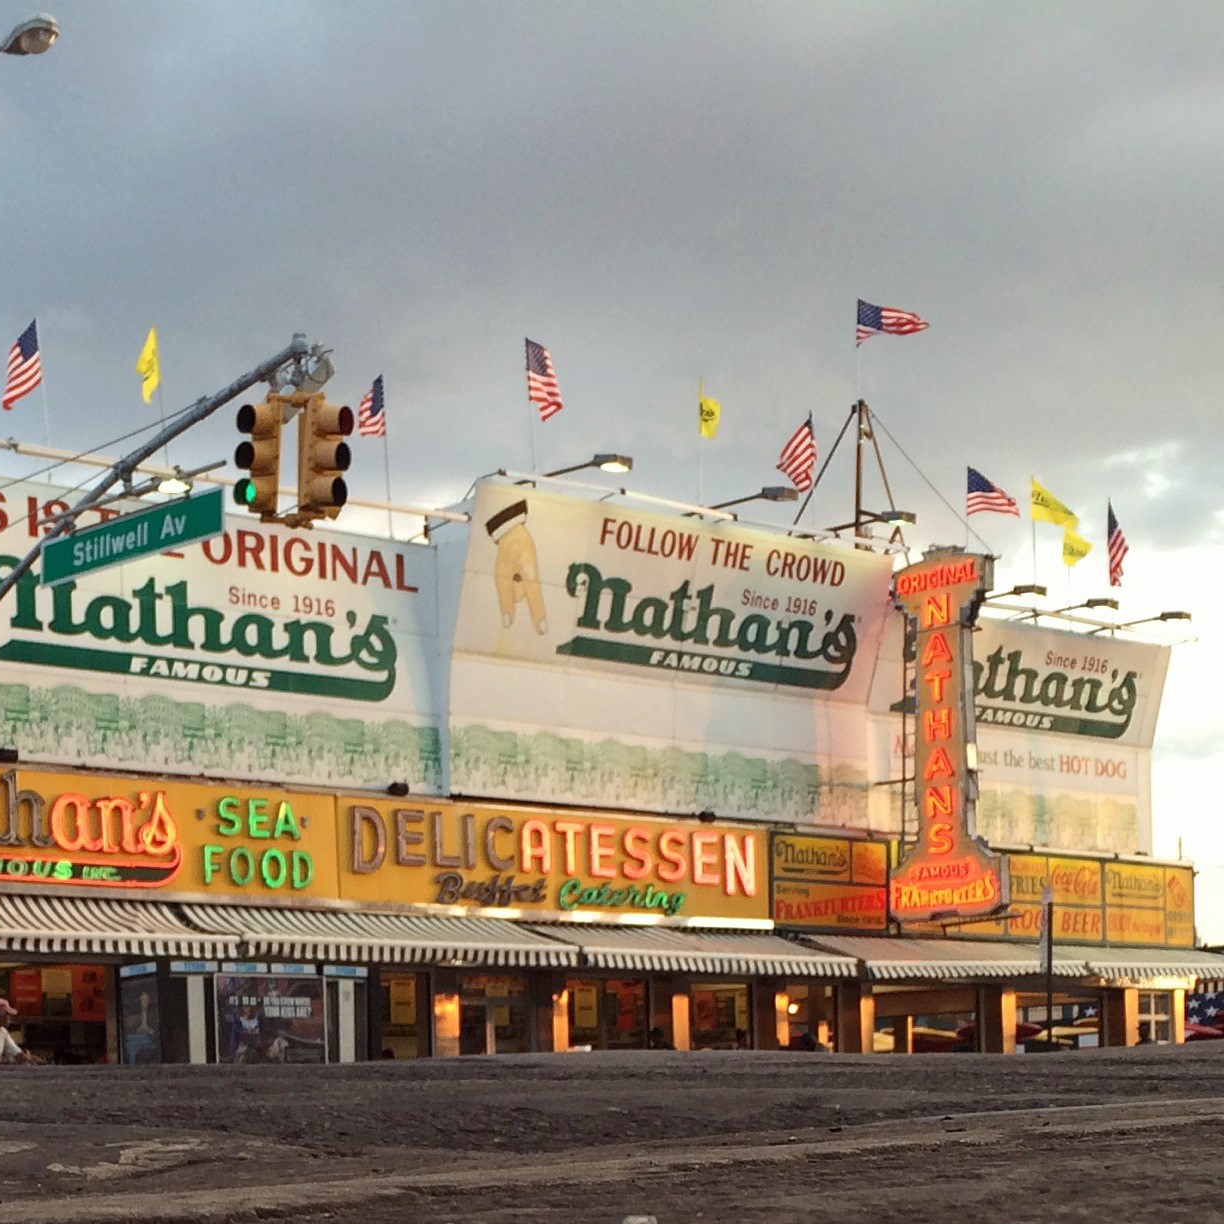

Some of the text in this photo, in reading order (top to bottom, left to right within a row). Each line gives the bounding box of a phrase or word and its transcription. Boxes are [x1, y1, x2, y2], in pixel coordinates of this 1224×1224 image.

[72, 521, 149, 567] Stillwell
[160, 513, 188, 541] Av
[599, 518, 847, 588] FOLLOW THE CROWD
[201, 529, 419, 594] ORIGINAL
[897, 558, 978, 595] ORIGINAL
[228, 586, 336, 618] Since 1916
[565, 562, 858, 665] Nathan's
[740, 588, 818, 617] Since 1916
[129, 656, 273, 688] FAMOUS
[649, 651, 753, 678] FAMOUS
[972, 644, 1137, 716] than's
[1045, 650, 1109, 674] Since 1916
[922, 591, 955, 856] NATHANS
[977, 749, 1128, 779] ust the best HOT DOG
[217, 795, 303, 841] SEA
[203, 843, 316, 890] FOOD
[350, 804, 758, 898] DELICATESSEN
[775, 840, 847, 868] Nathan's
[435, 871, 687, 916] Buffet Catering
[774, 889, 885, 920] FRANKFURTERS
[891, 871, 996, 910] FRANKFURTERS
[1061, 910, 1101, 934] BEER
